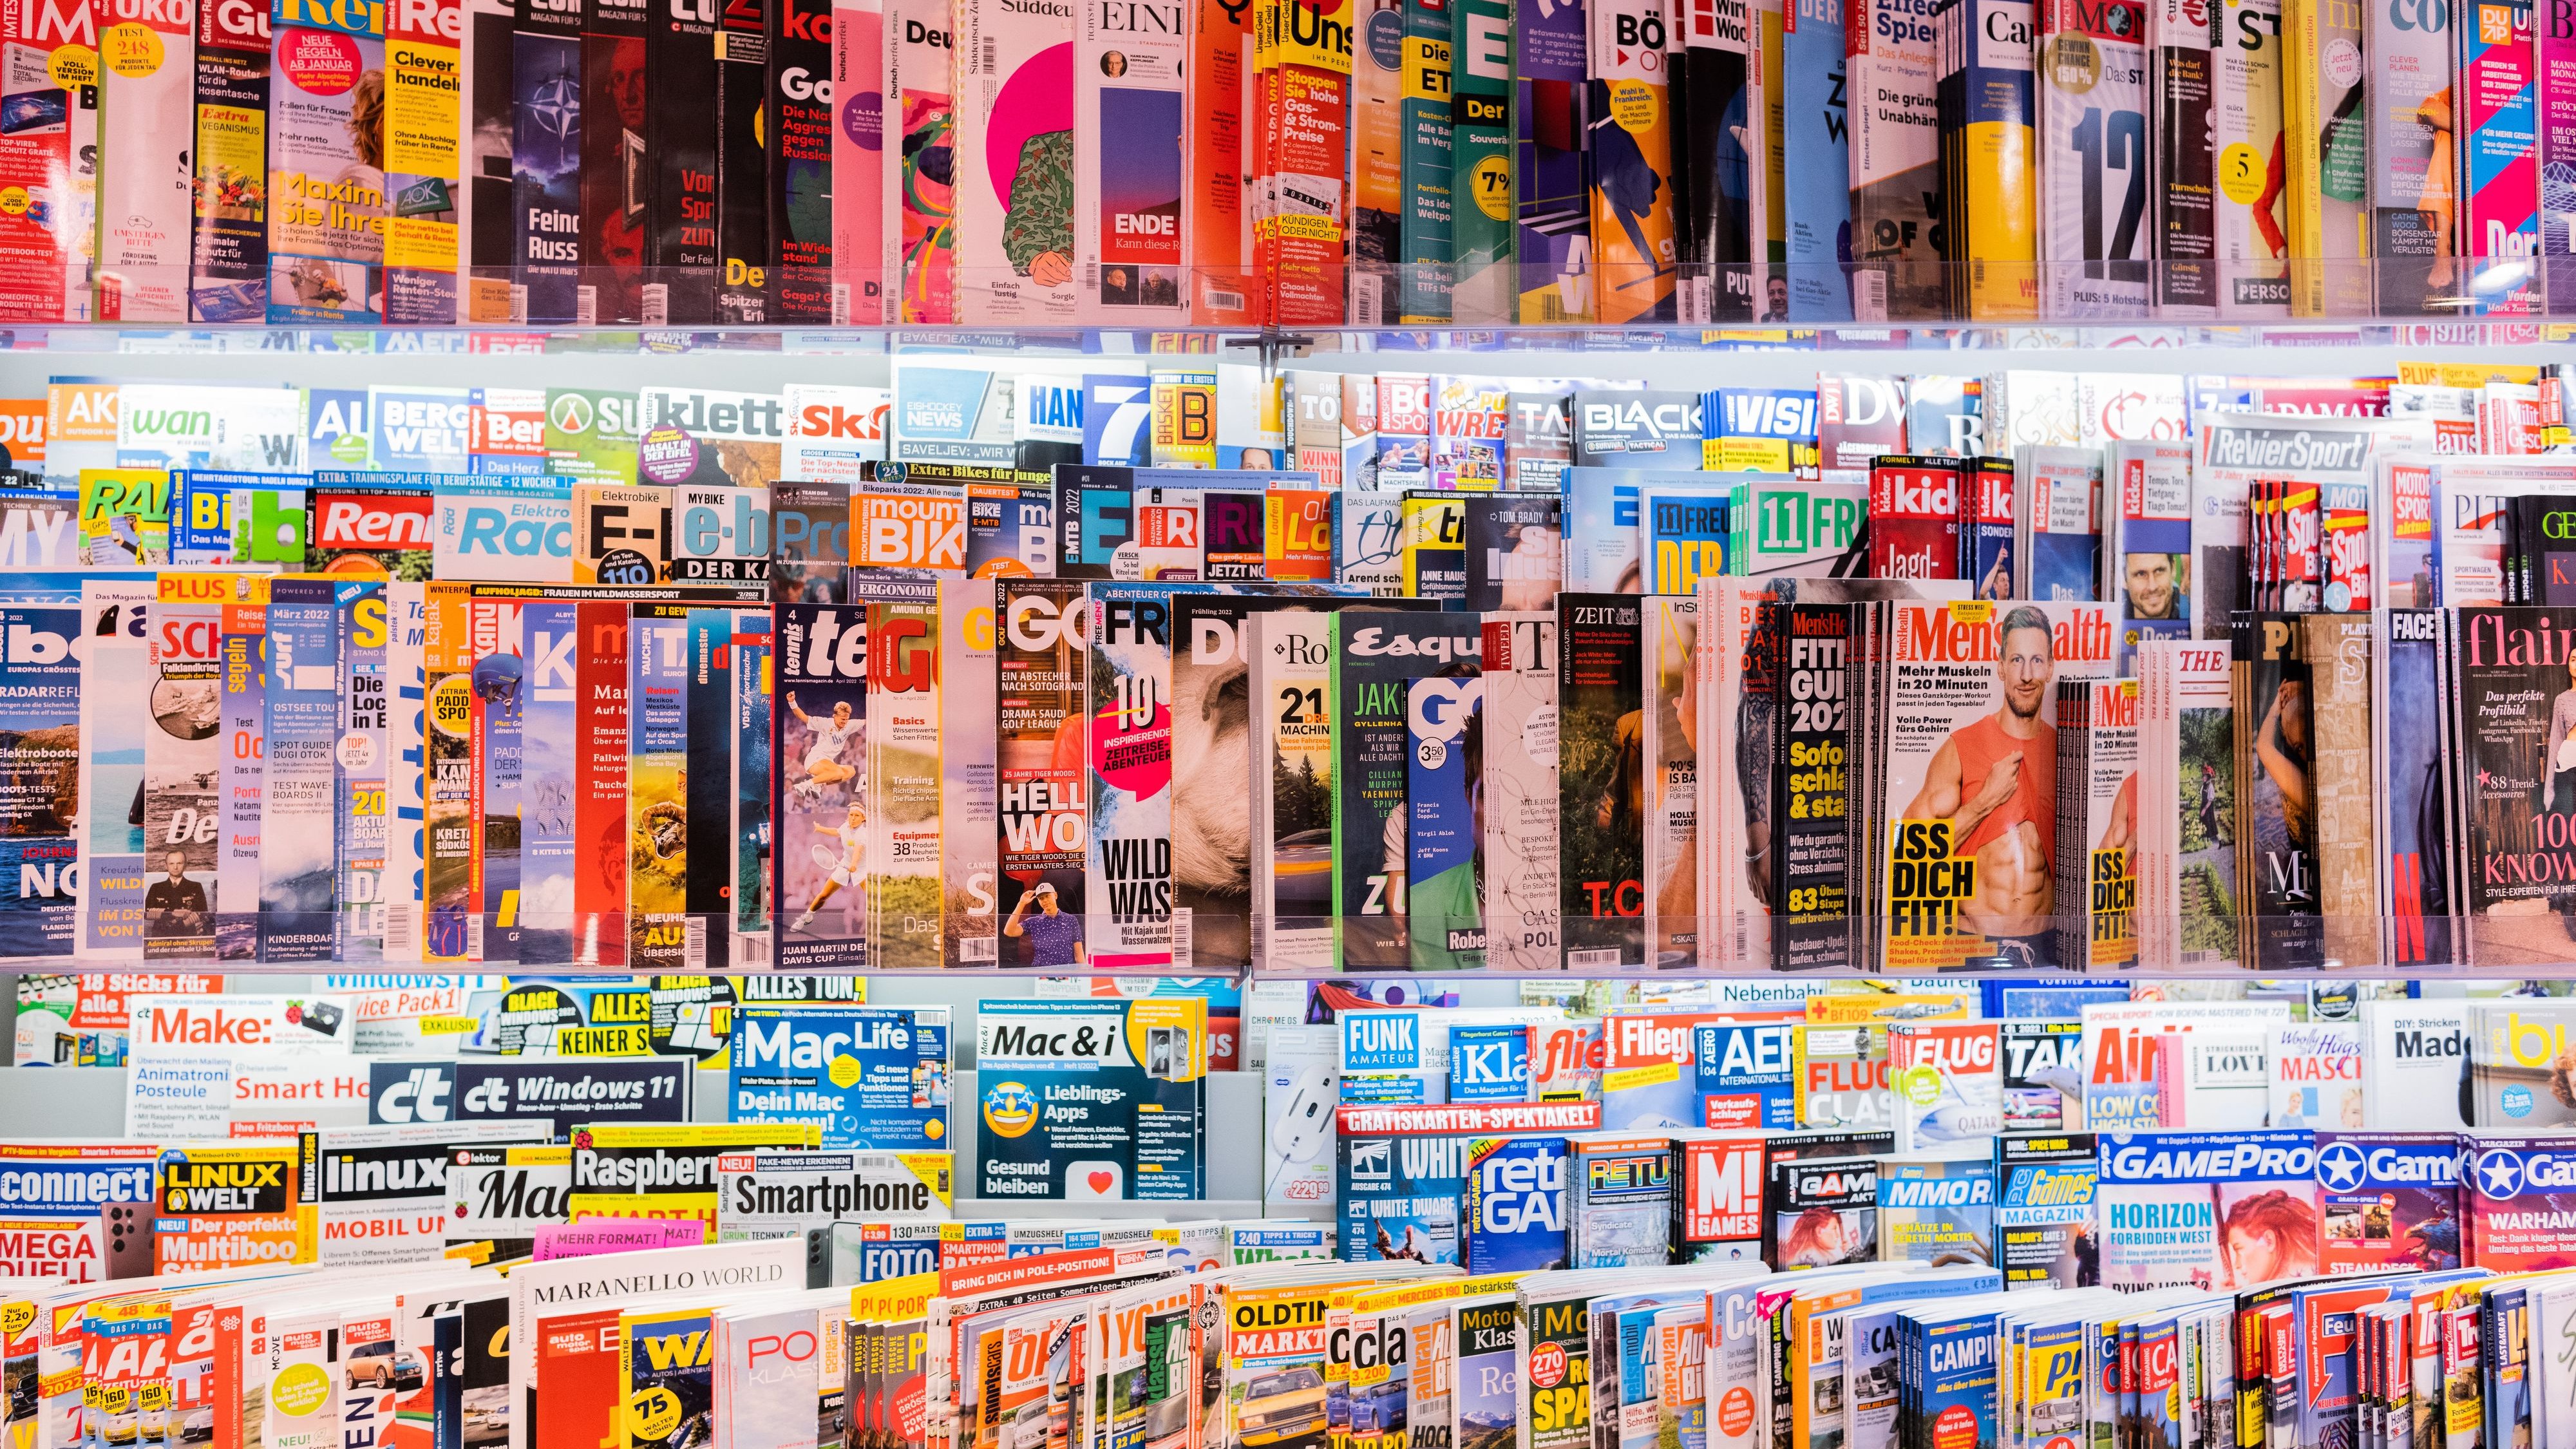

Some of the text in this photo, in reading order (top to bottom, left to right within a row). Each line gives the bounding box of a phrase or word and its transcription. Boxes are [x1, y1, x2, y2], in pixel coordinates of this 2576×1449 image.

[117, 28, 145, 38] TEST
[118, 41, 149, 56] 248
[302, 35, 332, 47] NEUE
[296, 47, 342, 58] REGELN
[198, 64, 261, 79] WLAN-Router
[290, 60, 352, 70] AB JANUAR
[2481, 61, 2506, 70] WERDEN
[1285, 70, 1338, 89] Stoppen
[2481, 71, 2521, 80] ARBEITGEBER
[2496, 82, 2522, 91] ZUKUNFT
[1285, 86, 1339, 104] Sie hohe
[1285, 100, 1318, 115] Gas-
[1468, 100, 1504, 120] Der
[202, 122, 260, 135] VEGANISMUS
[1285, 115, 1341, 131] & Strom-
[1283, 128, 1325, 142] Preise
[1115, 215, 1174, 235] ENDE
[992, 281, 1020, 290] Einfach
[994, 290, 1016, 299] lustig
[2401, 366, 2438, 384] PLUS
[907, 410, 962, 427] NEWS
[645, 443, 679, 454] BASALT
[646, 449, 691, 460] DER EIFEL
[903, 443, 970, 458] SAVELJEV:
[910, 464, 1011, 479] Extra: Bikes für
[319, 473, 348, 484] EXTRA:
[351, 472, 423, 485] TRAININGSPLÄNE
[426, 473, 442, 485] FÜR
[446, 473, 503, 487] BERUFSTÄTIGE
[511, 477, 518, 486] 12
[522, 477, 556, 487] WOCHEN
[602, 490, 659, 502] Elektrobike
[688, 493, 724, 504] MY BIKE
[1880, 475, 1890, 513] kicker
[511, 504, 569, 518] Elektro
[1499, 511, 1543, 524] TOM BRADY
[1880, 544, 1938, 579] Jagd-
[160, 579, 225, 598] PLUS
[475, 586, 679, 600] AUFHOLJAGD: FRAUEN IM WILDWASSERSPORT
[274, 609, 329, 620] März 2022
[1575, 608, 1615, 623] ZEIT
[2393, 614, 2435, 639] FACE
[163, 662, 220, 674] Falklandkrieg
[1899, 665, 1991, 677] Mehr Muskeln
[1001, 671, 1070, 681] EIN ABSTECHER
[1898, 679, 1988, 691] in 20 Minuten
[1897, 700, 1916, 708] passt
[1925, 699, 1944, 708] jeden
[1946, 699, 1985, 708] Tagesablauf
[2485, 690, 2544, 703] Das perfekte
[2479, 703, 2526, 717] Profilbild
[893, 717, 925, 726] Basics
[1897, 716, 1952, 725] Volle Power
[1896, 724, 1949, 734] fürs Gehirn
[346, 738, 366, 748] TOP!
[893, 775, 934, 786] Training
[1893, 825, 1949, 859] ISS
[1893, 862, 1973, 898] DICH
[2486, 886, 2575, 897] STYLE-EXPERTEN FÜR IHRE
[1891, 900, 1954, 937] FIT!
[782, 945, 848, 955] JUAN MARTIN
[783, 954, 835, 964] DAVIS CUP
[151, 1008, 272, 1043] Make:
[1350, 1018, 1414, 1050] FUNK
[1350, 1053, 1414, 1065] AMATEUR
[518, 1075, 676, 1101] Windows 11
[1045, 1084, 1126, 1103] Lieblings-
[738, 1092, 844, 1111] Dein Mac
[1045, 1104, 1088, 1121] Apps
[1348, 1104, 1593, 1132] GRATISKARTEN-SPEKTAKEL!
[170, 1164, 281, 1187] LINUX
[986, 1159, 1050, 1177] Gesund
[1, 1166, 149, 1203] connect
[986, 1177, 1049, 1195] bleiben
[1351, 1182, 1379, 1191] AUSGABE
[189, 1188, 260, 1211] WELT
[1371, 1198, 1455, 1218] WHITE DWARF
[2006, 1207, 2085, 1224] MAGAZIN
[158, 1220, 186, 1231] NEU!
[1698, 1215, 1759, 1236] GAMES
[557, 1232, 658, 1245] MEHR FORMAT!
[952, 1257, 1110, 1291] BRING DICH IN POLE-POSITION!
[535, 1264, 782, 1305] MARANELLO WORLD
[979, 1300, 1008, 1311] EXTRA:
[1012, 1296, 1023, 1305] 40
[1027, 1292, 1056, 1303] Seiten
[1061, 1276, 1158, 1298] Sommerfelgen-Ratgeber
[1357, 1285, 1460, 1311] 40 JAHRE MERCEDES 190
[4, 1311, 28, 1323] 2,20
[1533, 1353, 1562, 1372] 270
[634, 1399, 668, 1419] 75
[643, 1416, 674, 1432] WALTER
[279, 1436, 310, 1448] NEU!
